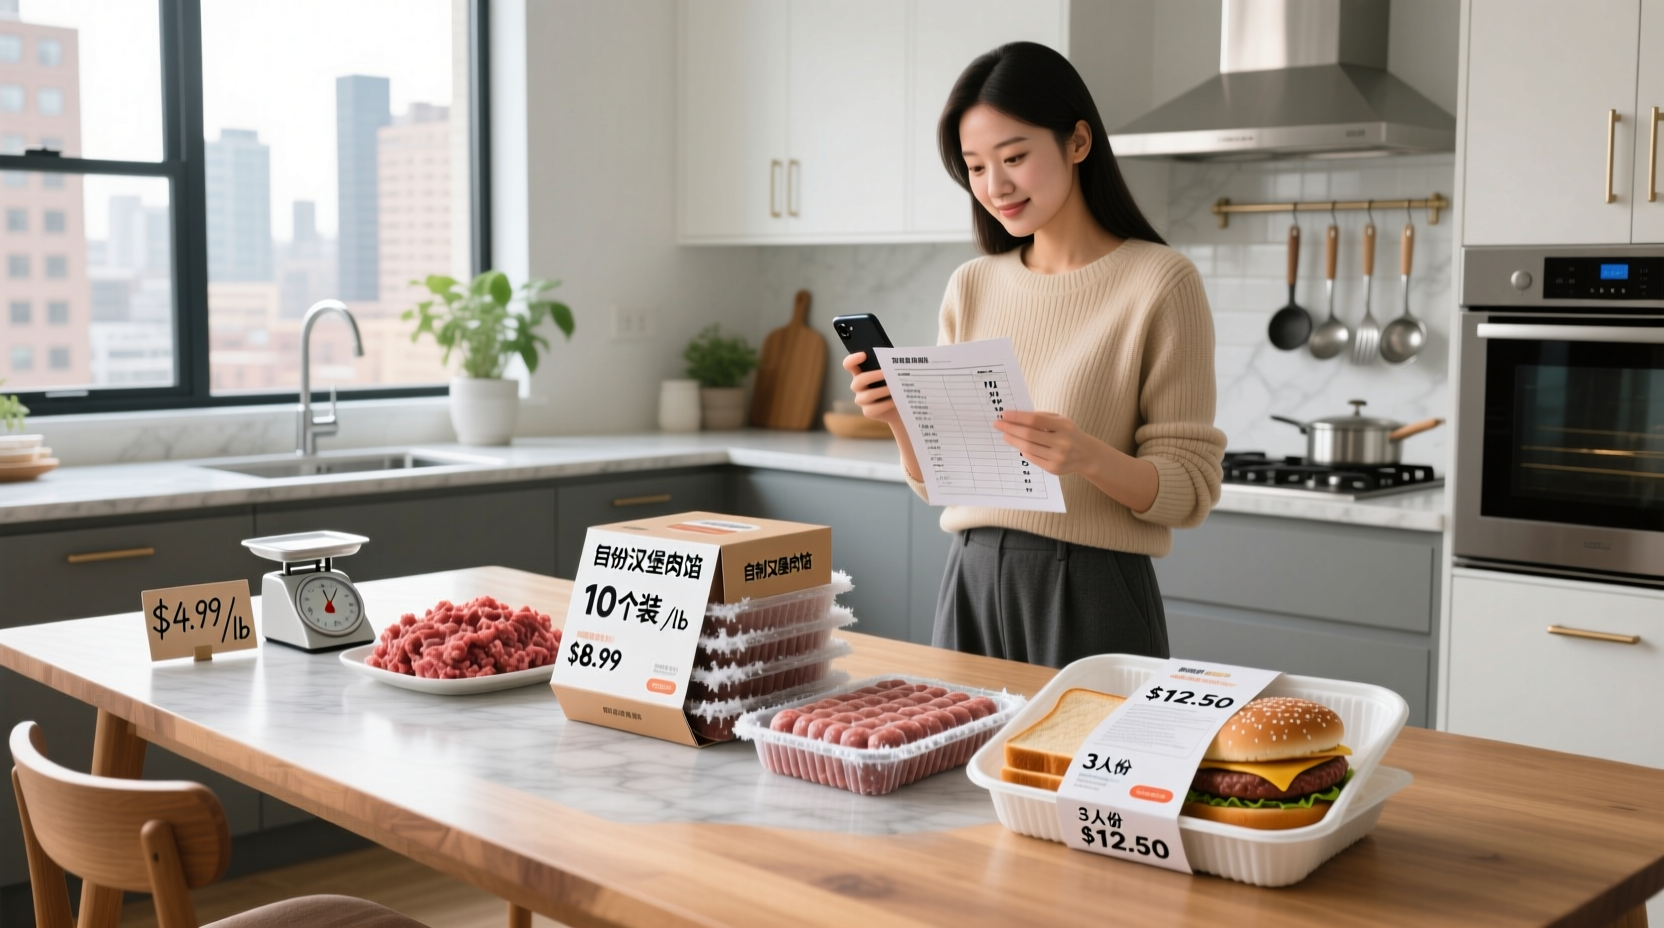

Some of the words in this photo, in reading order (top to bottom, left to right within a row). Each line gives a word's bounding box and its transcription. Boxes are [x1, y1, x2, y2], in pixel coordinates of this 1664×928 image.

[153, 597, 250, 643] $4.99/lb
[585, 583, 663, 625] 10个装
[659, 606, 689, 632] /lb
[567, 640, 622, 671] $8.99
[1145, 686, 1235, 709] $12.50
[1082, 753, 1132, 776] 3人份
[1078, 806, 1123, 829] 3人份
[1081, 826, 1170, 859] $12.50
